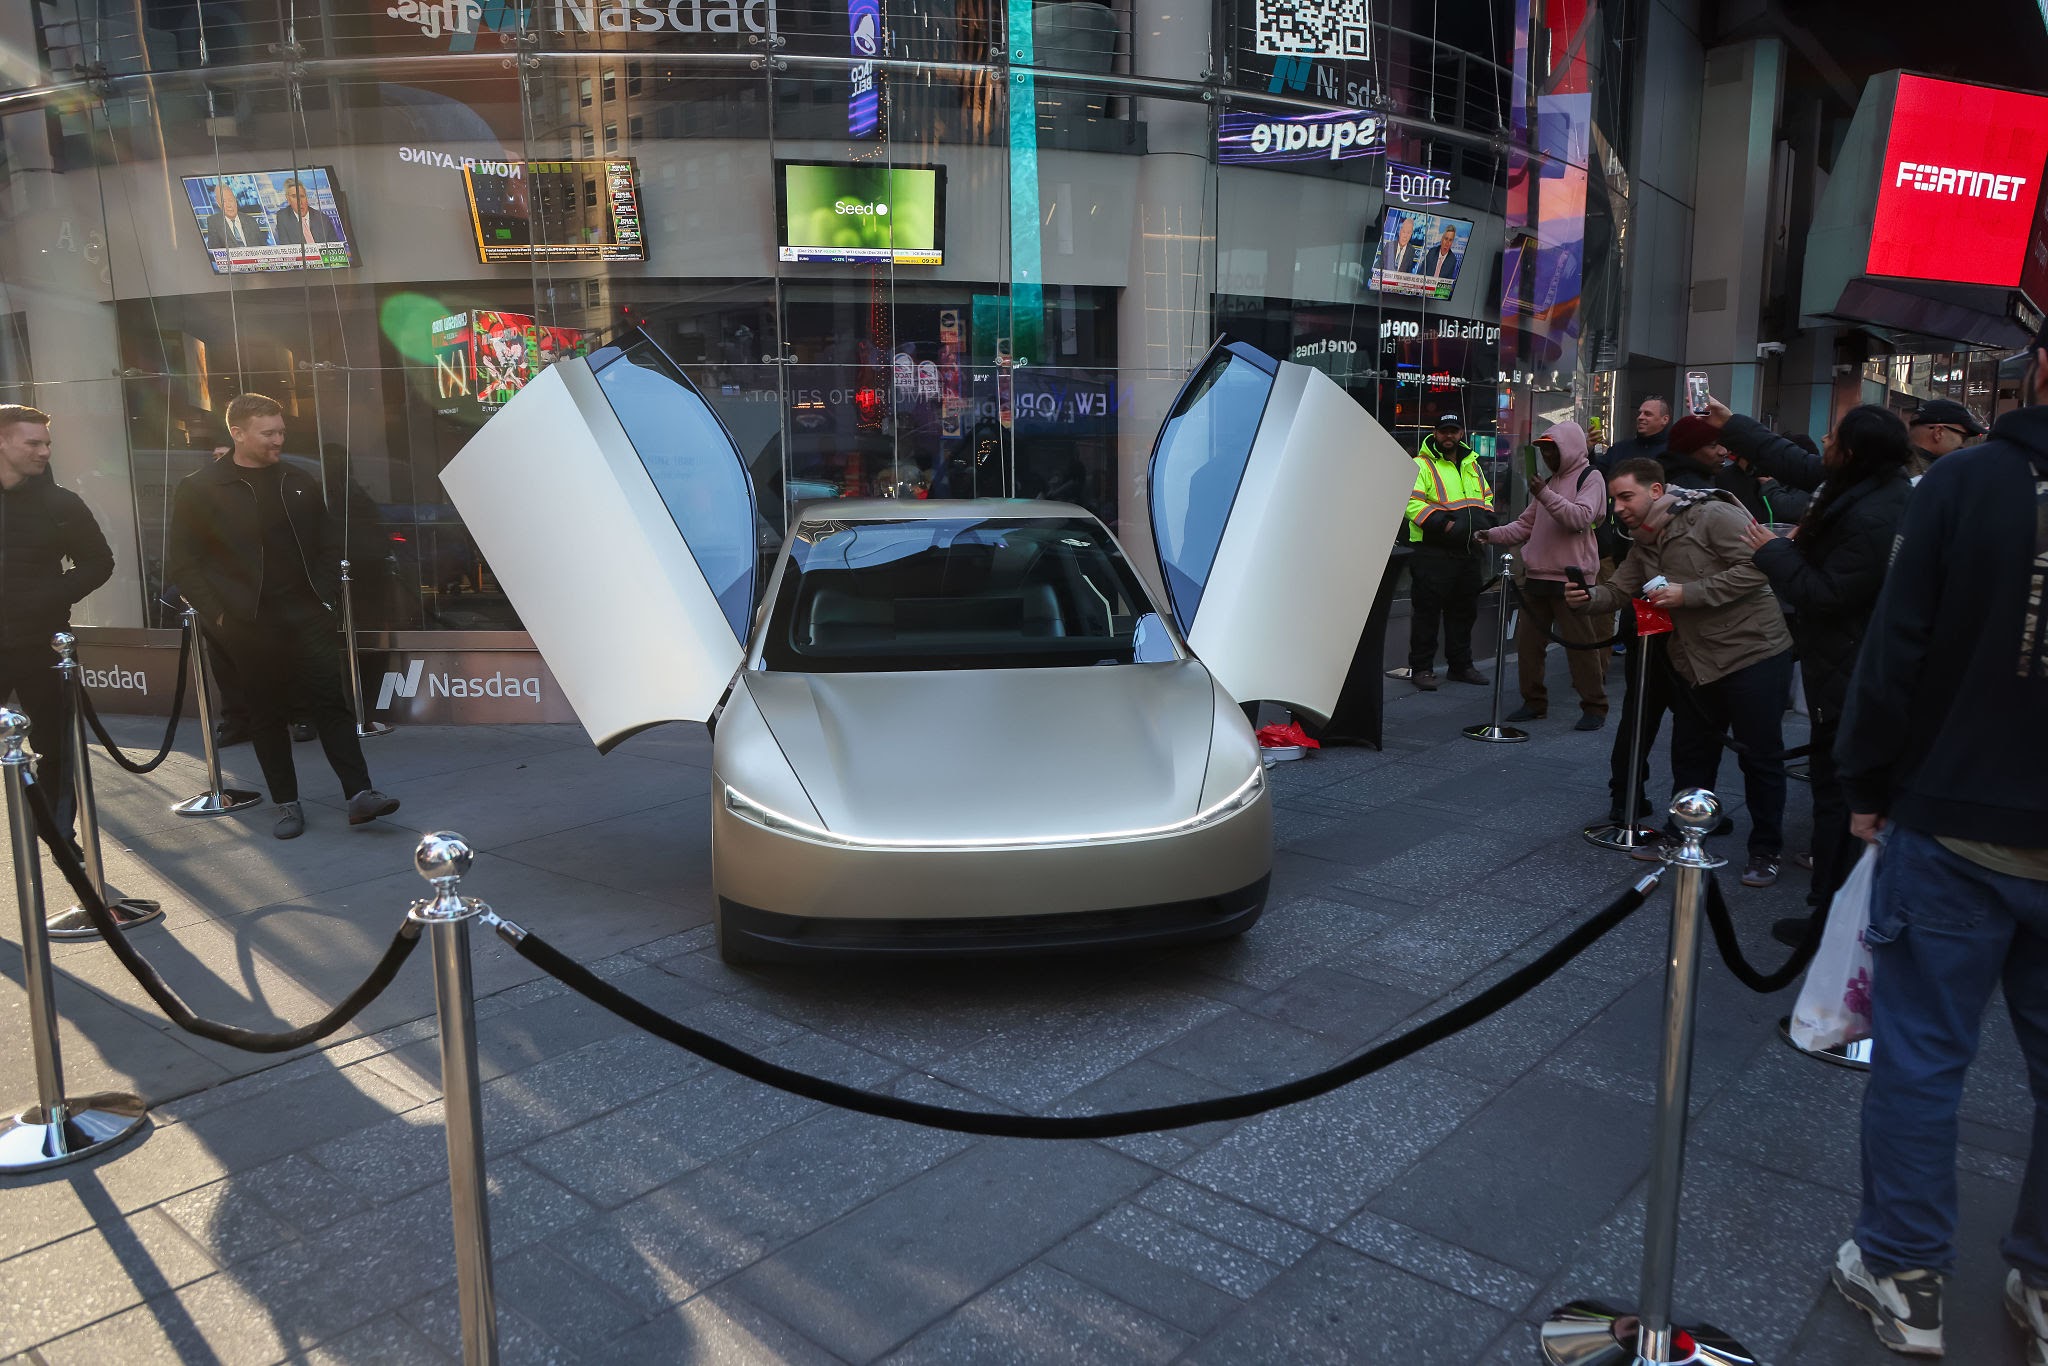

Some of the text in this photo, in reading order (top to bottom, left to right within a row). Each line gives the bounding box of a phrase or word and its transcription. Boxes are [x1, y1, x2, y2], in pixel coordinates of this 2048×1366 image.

[1895, 161, 2027, 202] FORTINET
[835, 201, 874, 215] Seed
[829, 389, 855, 405] OF
[428, 671, 541, 704] Nasdaq
